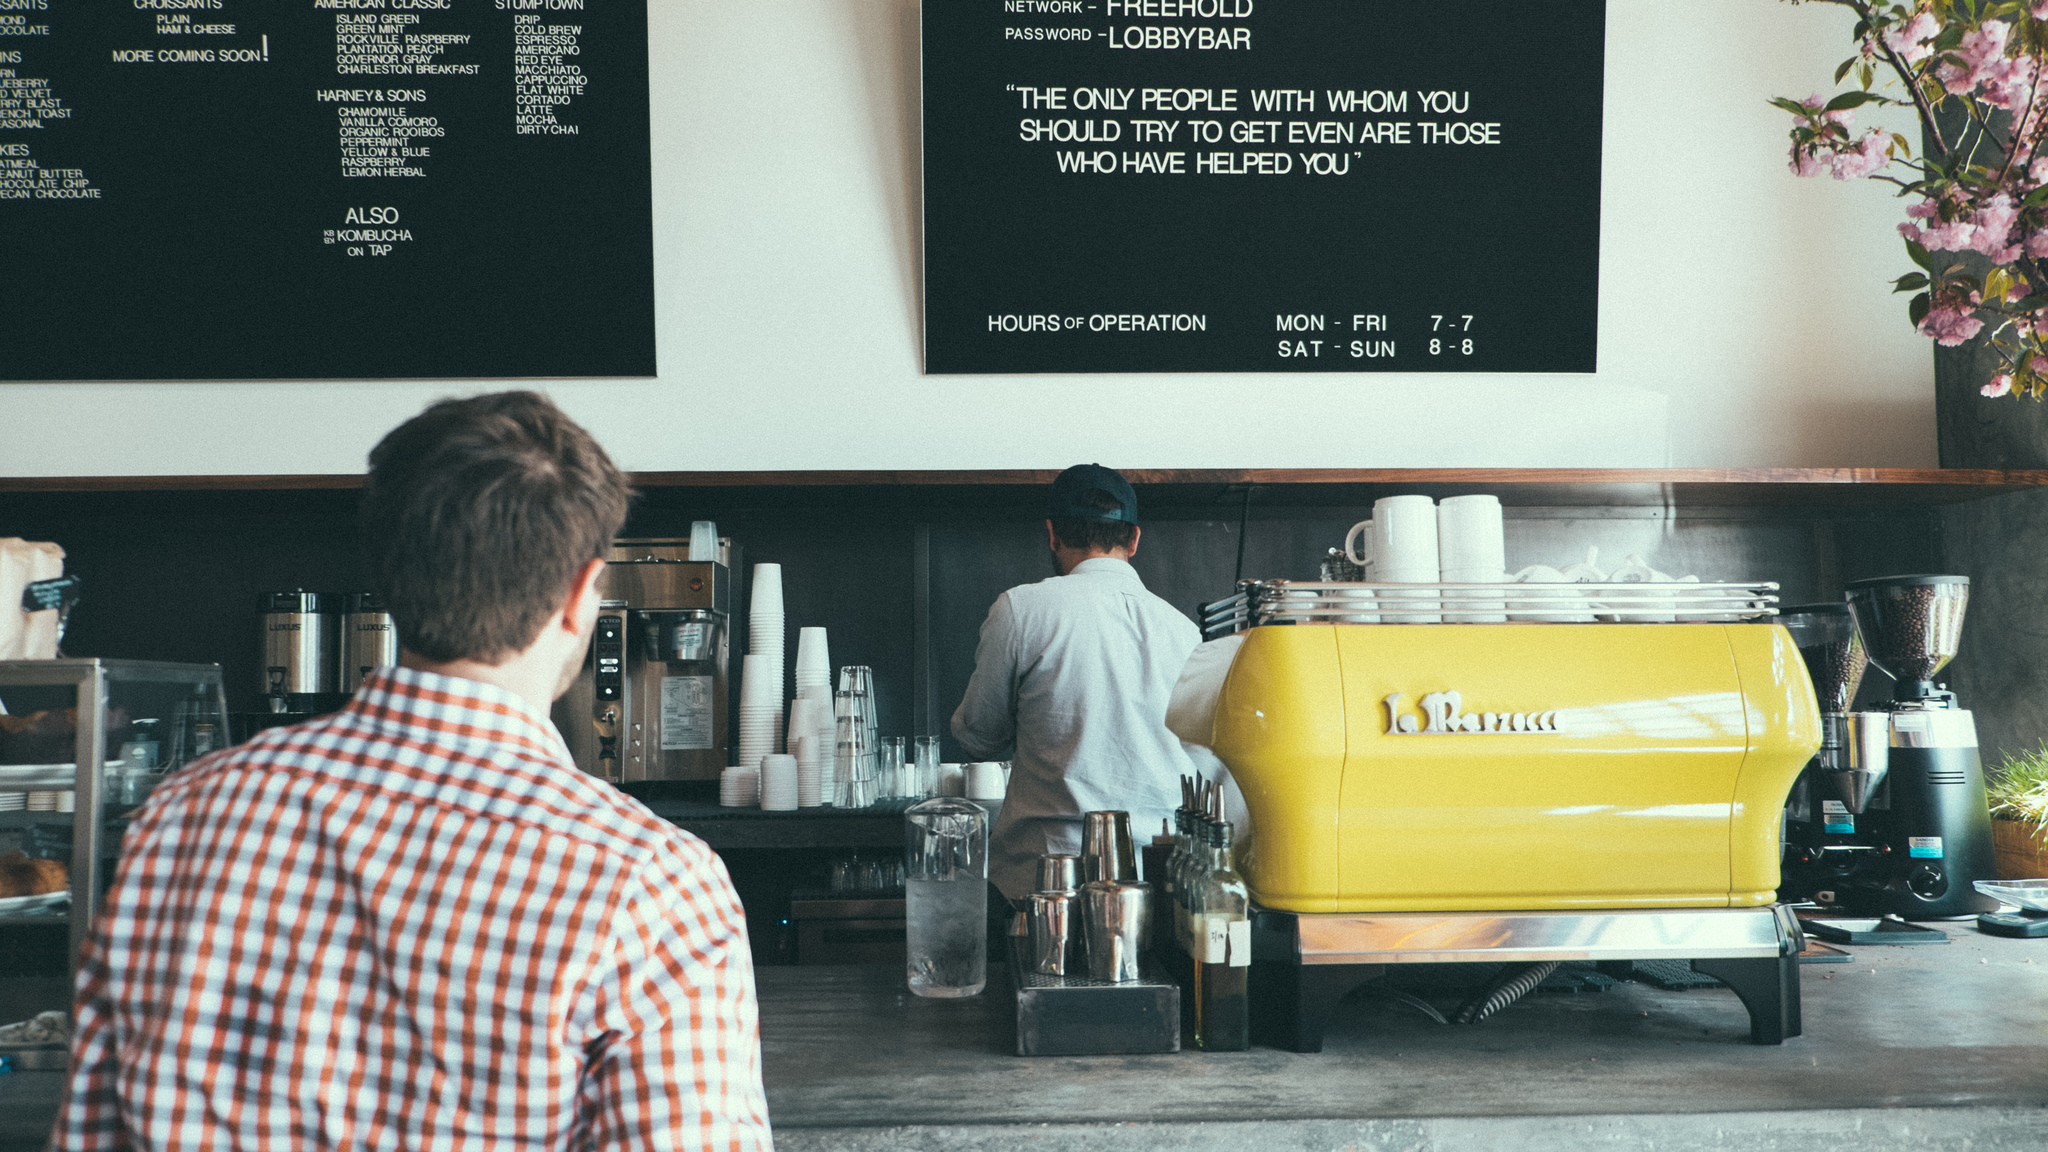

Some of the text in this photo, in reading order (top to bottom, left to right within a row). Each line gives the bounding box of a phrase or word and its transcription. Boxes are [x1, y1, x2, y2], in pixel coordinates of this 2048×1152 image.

[0, 0, 47, 10] SANTS
[134, 0, 222, 9] CROISSANTS
[315, 0, 450, 9] AMERICAN CLASSIC
[496, 0, 583, 10] STUMPTOWN
[1005, 0, 1082, 13] NETWORK
[1108, 0, 1253, 17] FREEHOLD
[157, 15, 190, 24] PLAIN
[337, 14, 419, 23] ISLAND GREEN
[515, 15, 540, 24] DRIP
[157, 24, 235, 34] HAM & CHEESE
[336, 24, 404, 34] GREEN MINT
[515, 25, 581, 36] COLD BREW
[1006, 28, 1091, 40] PASSWORD
[337, 34, 470, 44] ROCKVILLE RASPBERRY
[516, 35, 576, 46] ESPRESSO
[113, 35, 268, 62] MORE COMING SOON!
[337, 45, 443, 54] PLANTATION PEACH
[515, 45, 580, 55] AMERICANO
[337, 55, 432, 64] GOVERNOR GRAY
[515, 55, 562, 65] RED EYE
[337, 65, 479, 74] CHARLESTON BREAKFAST
[516, 65, 580, 75] MACCHIATO
[515, 75, 587, 85] CAPPUCCINO
[12, 89, 51, 98] VELVET
[517, 85, 583, 94] FLAT WHITE
[318, 90, 426, 101] HARNEY & SONS
[516, 95, 570, 104] CORTADO
[1073, 88, 1134, 110] ONLY
[1142, 89, 1237, 111] PEOPLE
[1251, 90, 1314, 111] WITH
[1327, 90, 1407, 112] WHOM
[1418, 91, 1469, 113] YOU
[27, 99, 61, 108] BLAST
[0, 109, 71, 118] ENCH TOAST
[339, 107, 406, 116] CHAMOMILE
[517, 105, 552, 114] LATTE
[0, 119, 43, 128] ASONAL
[340, 117, 437, 127] VANILLA COMORO
[516, 115, 557, 124] MOCHA
[340, 127, 444, 136] ORGANIC ROOIBOS
[517, 125, 578, 134] DIRTY CHAI
[1020, 119, 1500, 144] SHOULD TRY TO GET EVEN ARE THOSE
[341, 138, 409, 146] PEPPERMINT
[341, 147, 430, 156] YELLOW & BLUE
[342, 157, 405, 166] RASPBERRY
[1057, 151, 1117, 173] WHO
[1123, 152, 1185, 173] HAVE
[1197, 152, 1292, 174] HELPED
[40, 169, 83, 178] BUTTER
[343, 168, 426, 177] LEMON HERBAL
[63, 179, 89, 188] CHIP
[36, 189, 100, 198] CHOCOLATE
[346, 207, 398, 224] ALSO
[337, 230, 412, 241] KOMBUCHA
[348, 245, 392, 256] ON TAP
[989, 314, 1205, 331] HOURS OF OPERATION
[1277, 314, 1324, 331] MON
[1354, 315, 1386, 331] FRI
[1431, 315, 1442, 331] 7
[1462, 315, 1473, 331] 7
[1278, 341, 1323, 357] SAT
[1351, 341, 1394, 357] SUN
[1430, 339, 1440, 355] 8
[1462, 339, 1473, 355] 8
